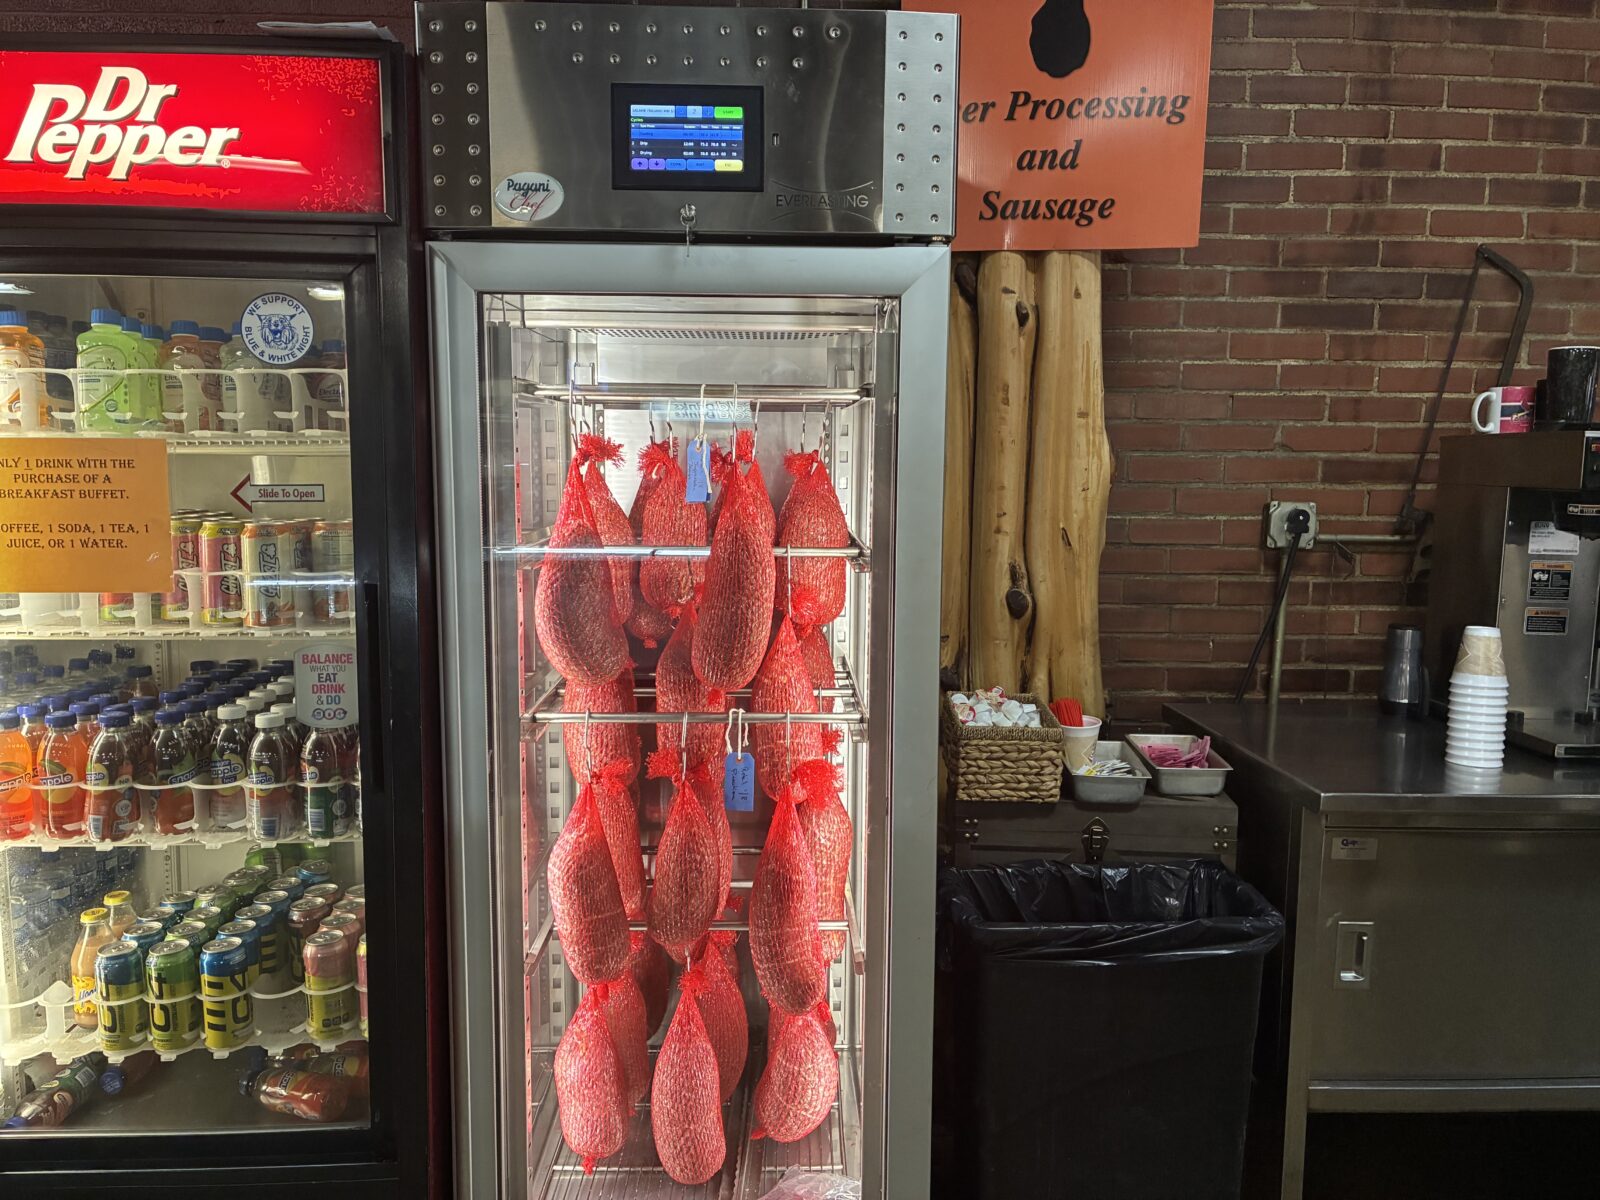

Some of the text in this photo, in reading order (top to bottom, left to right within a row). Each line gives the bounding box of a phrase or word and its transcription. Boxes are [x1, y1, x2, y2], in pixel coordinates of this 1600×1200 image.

[80, 66, 178, 123] Dr
[959, 86, 1191, 125] er Processing
[4, 84, 240, 181] Pepper
[1016, 139, 1083, 171] and
[506, 178, 551, 197] Pagani
[775, 193, 869, 208] EVERLASTING
[978, 190, 1116, 227] Sausage
[246, 295, 306, 316] WE SUPPORT
[244, 325, 311, 362] BLUE & WHITE NIGHT
[0, 457, 136, 470] NLY 1 DRINK WITH THE
[13, 474, 112, 484] PURCHASE OF A
[0, 489, 130, 499] BREAKFAST BUFFET.
[258, 488, 315, 500] Slide To Open
[0, 524, 149, 534] OFFEE, 1 SODA, 1 TEA, 1
[6, 537, 128, 549] JUICE, OR 1 WATER.
[302, 654, 353, 665] BALANCE
[309, 664, 330, 672] WHAT
[317, 673, 338, 683] EAT
[311, 684, 346, 695] DRINK
[316, 695, 341, 705] & DO
